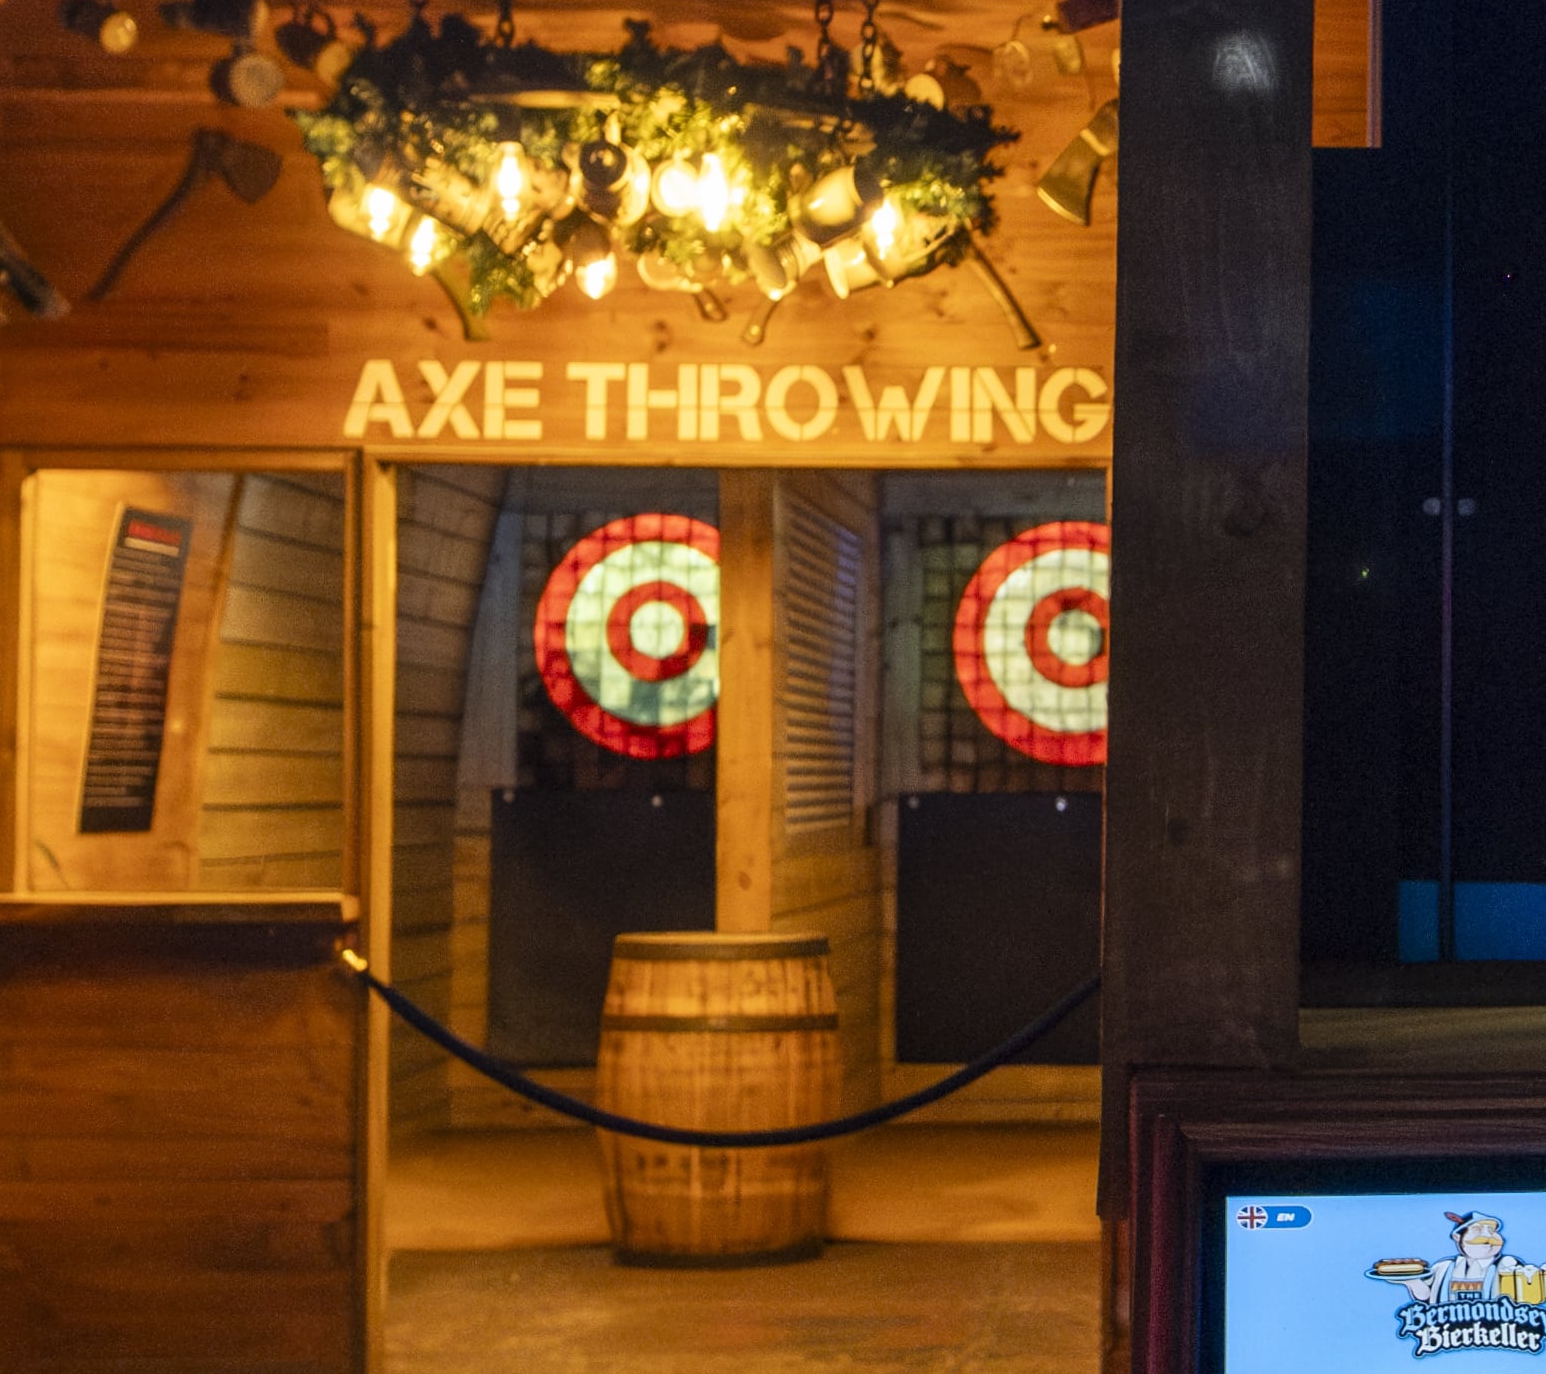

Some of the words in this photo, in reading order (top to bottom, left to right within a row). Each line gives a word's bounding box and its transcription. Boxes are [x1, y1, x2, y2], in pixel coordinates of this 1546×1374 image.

[343, 359, 543, 441] AXE
[566, 364, 1112, 445] THROWING
[1276, 1213, 1295, 1222] EN
[1416, 1321, 1541, 1355] Bierkeller
